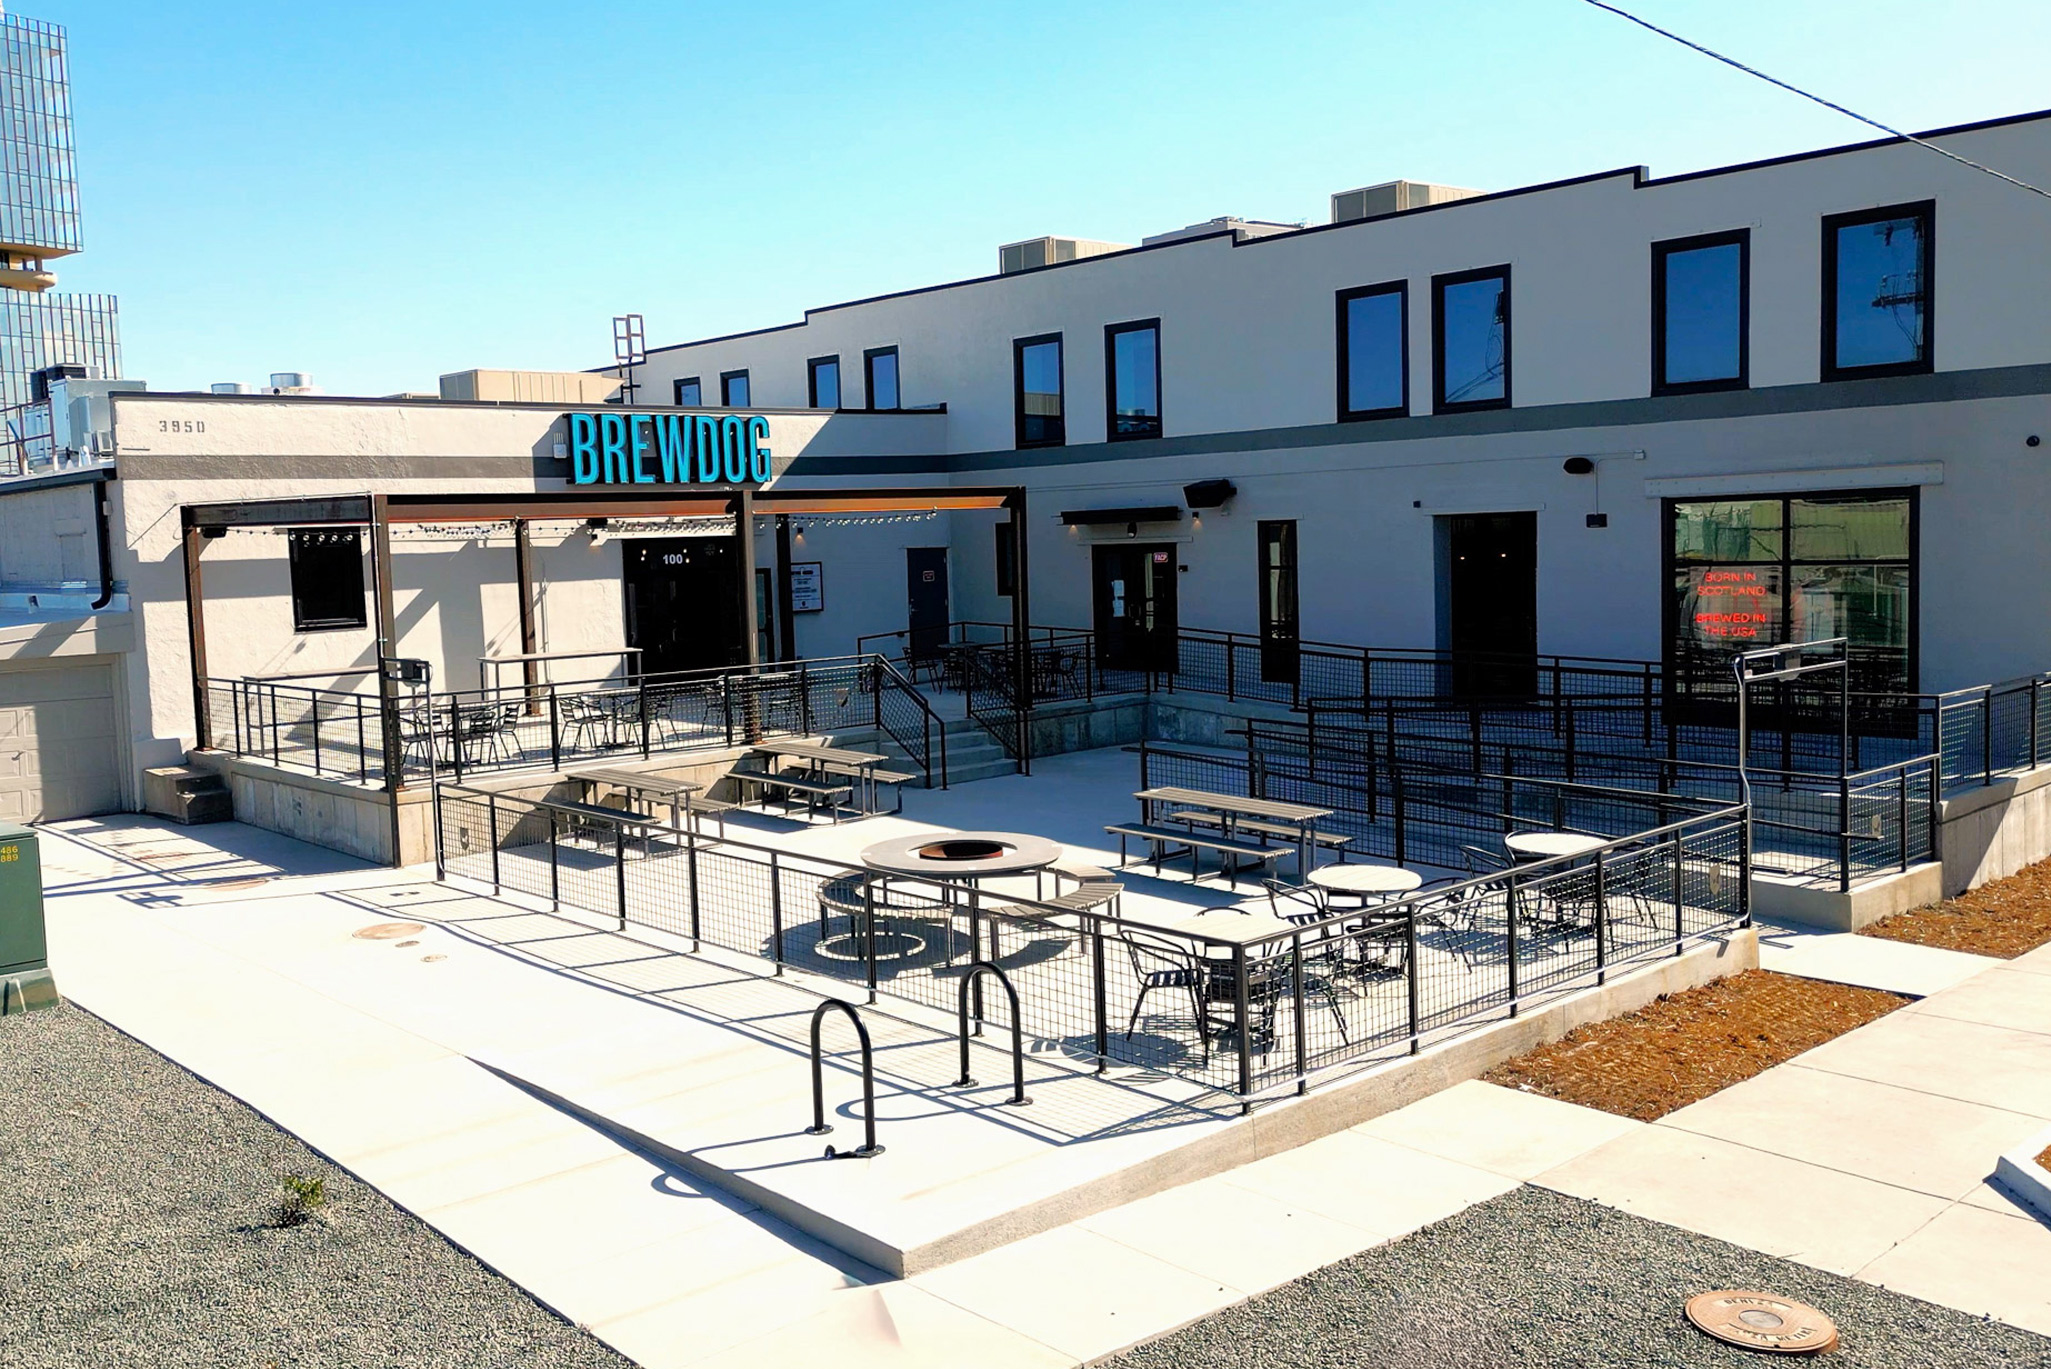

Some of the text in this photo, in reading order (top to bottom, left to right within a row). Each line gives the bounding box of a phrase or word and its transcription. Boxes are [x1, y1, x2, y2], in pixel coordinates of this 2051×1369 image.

[158, 420, 206, 433] 3950
[570, 413, 773, 485] BREWDOG
[662, 553, 684, 565] 100
[1705, 572, 1756, 582] BORN IN
[1697, 585, 1767, 596] SCOTLAND
[1695, 612, 1767, 623] BREWED IN
[1704, 625, 1757, 638] THE USA
